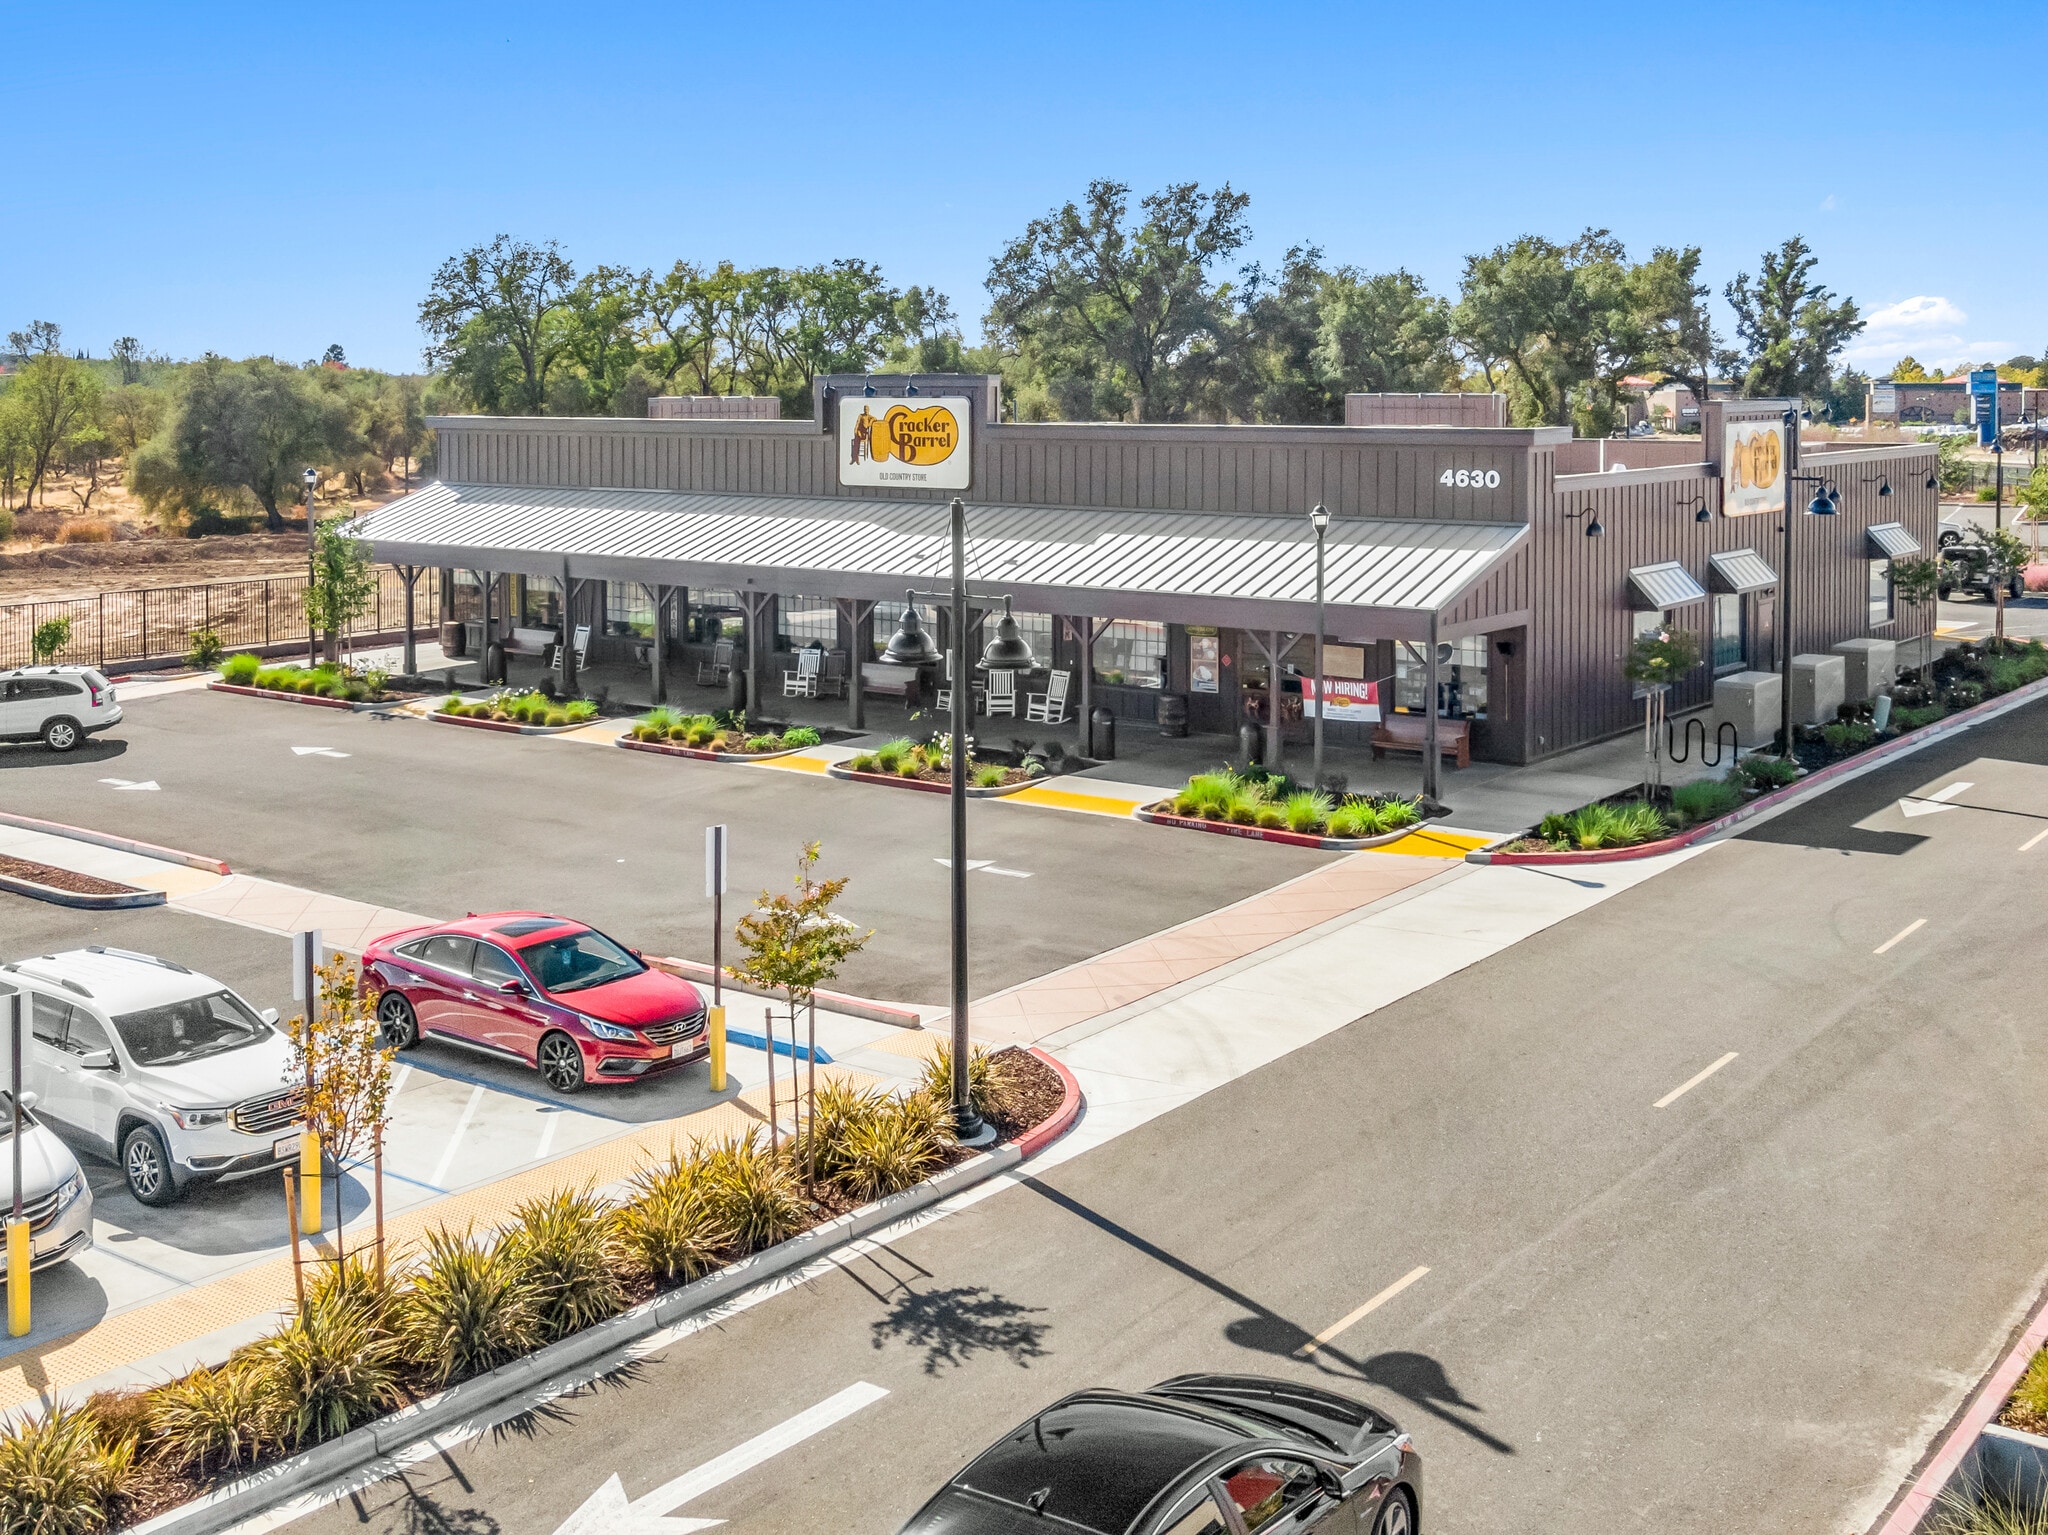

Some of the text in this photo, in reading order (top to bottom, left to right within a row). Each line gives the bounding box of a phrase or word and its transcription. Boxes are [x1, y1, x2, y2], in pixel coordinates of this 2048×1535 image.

[889, 412, 950, 446] Cracker
[898, 433, 951, 463] Barrel
[879, 472, 928, 482] OLD COUNTRY STORE
[1440, 469, 1500, 489] 4630
[1310, 680, 1369, 700] NW HIRING!
[1179, 820, 1207, 830] PARKING
